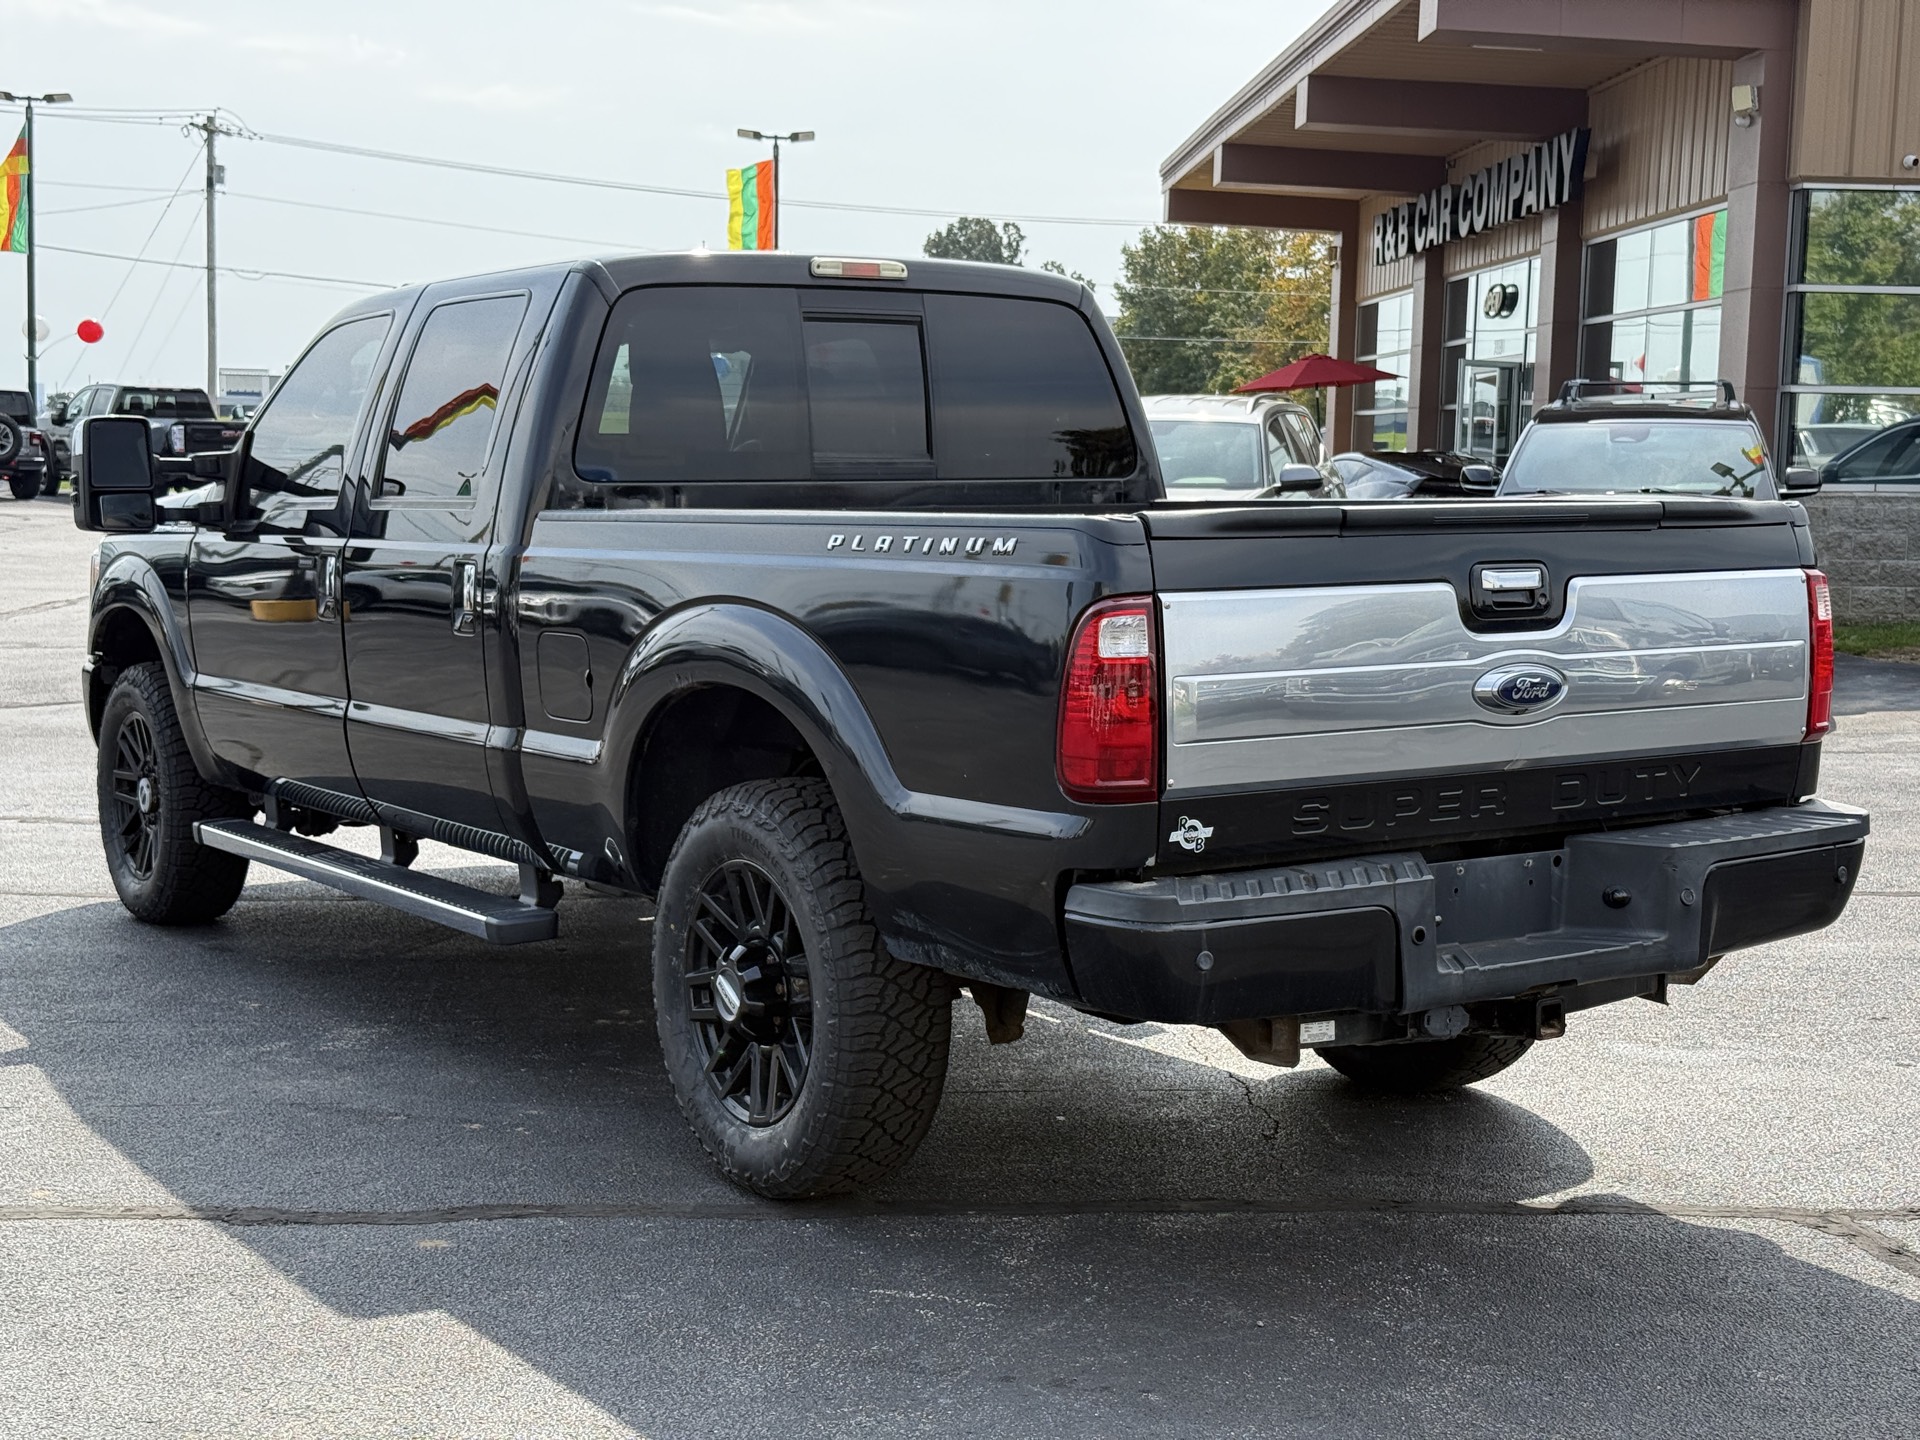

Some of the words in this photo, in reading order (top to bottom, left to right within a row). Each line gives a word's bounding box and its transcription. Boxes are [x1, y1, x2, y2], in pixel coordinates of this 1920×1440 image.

[1373, 202, 1410, 266] R&B
[1414, 184, 1451, 252] CAR
[1458, 127, 1577, 238] COMPANY
[827, 534, 1019, 556] PLATINUM
[1512, 677, 1550, 700] Ford
[1291, 781, 1507, 835] SUPER
[1551, 763, 1702, 810] DUTY
